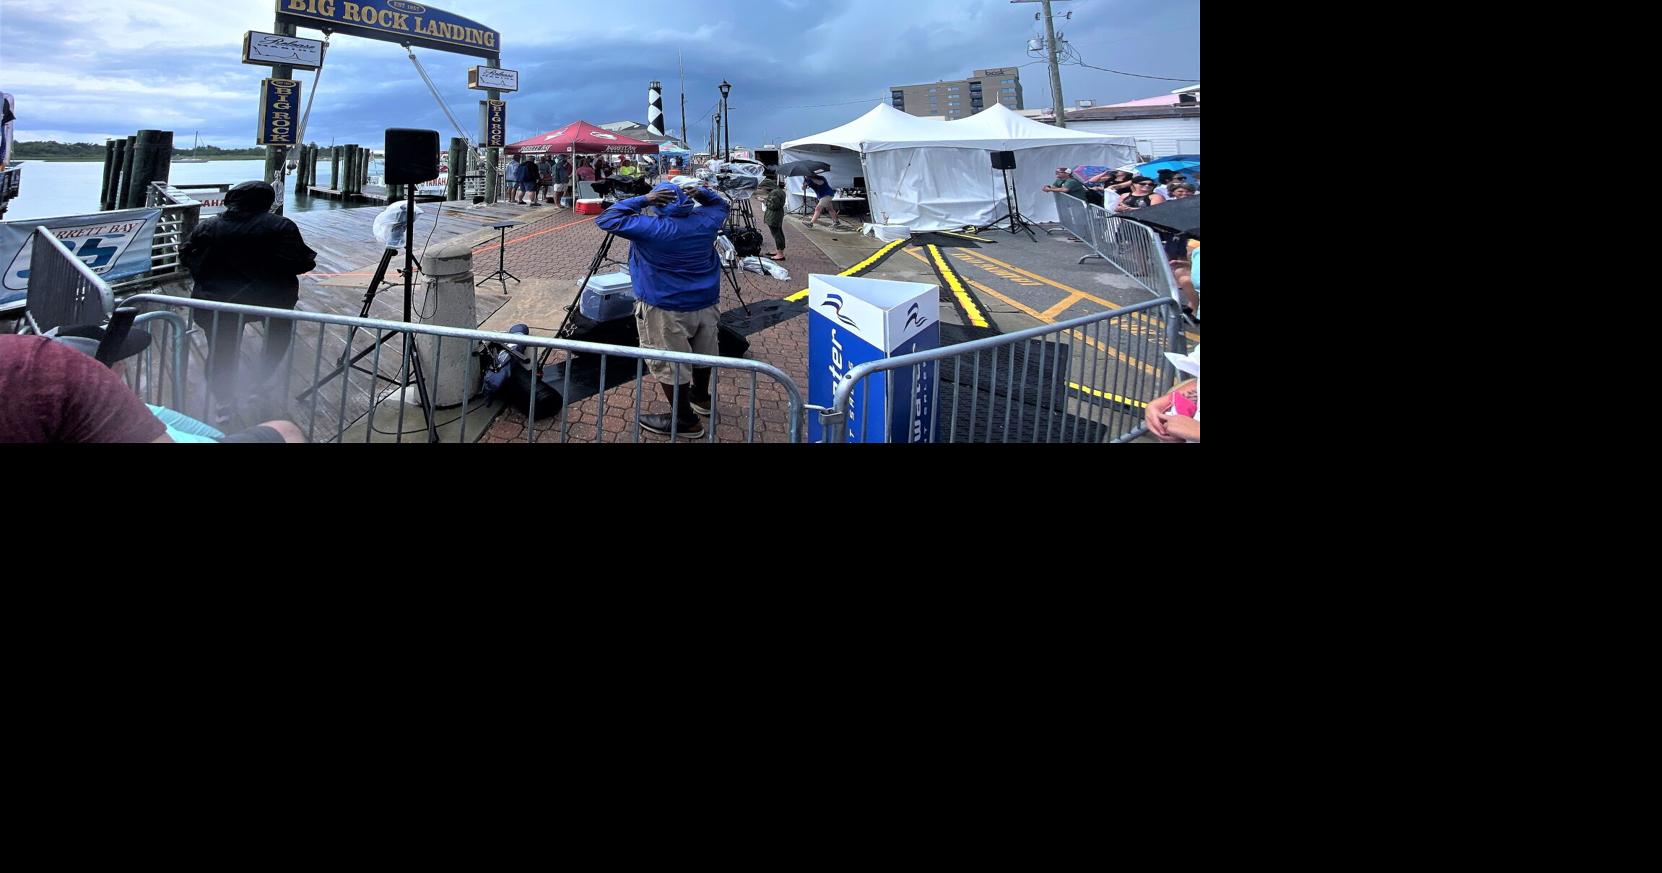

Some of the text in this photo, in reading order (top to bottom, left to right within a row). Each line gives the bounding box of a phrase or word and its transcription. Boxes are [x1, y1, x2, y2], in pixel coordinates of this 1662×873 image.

[342, 2, 409, 31] ROCK
[414, 16, 496, 48] LANDING
[273, 87, 292, 110] BIG
[270, 111, 291, 142] ROCK
[52, 223, 139, 239] RRETT BAY
